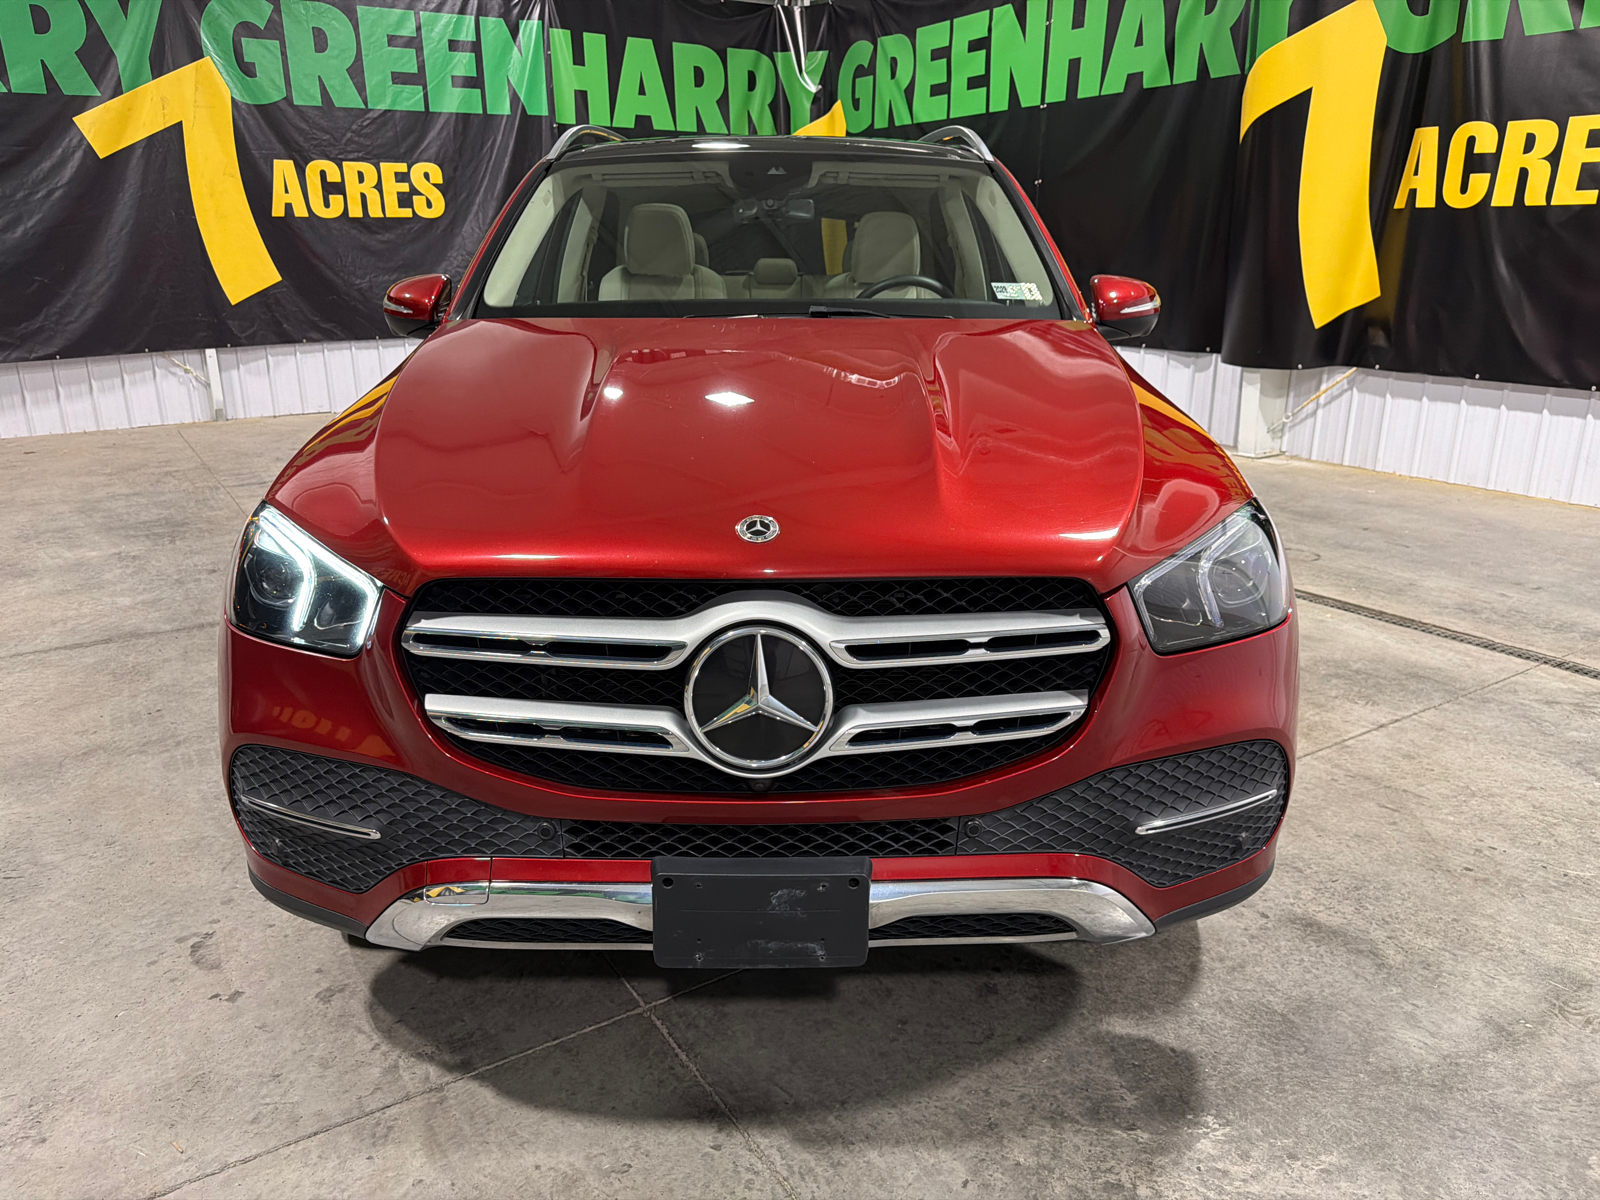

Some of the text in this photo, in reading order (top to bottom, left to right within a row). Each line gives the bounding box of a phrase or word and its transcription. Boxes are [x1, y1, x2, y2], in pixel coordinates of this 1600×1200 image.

[200, 0, 549, 116] GREEN
[549, 0, 1048, 136] HARRY GREEN
[72, 56, 446, 305] 7 ACRES
[1240, 0, 1600, 329] 7 ACRE
